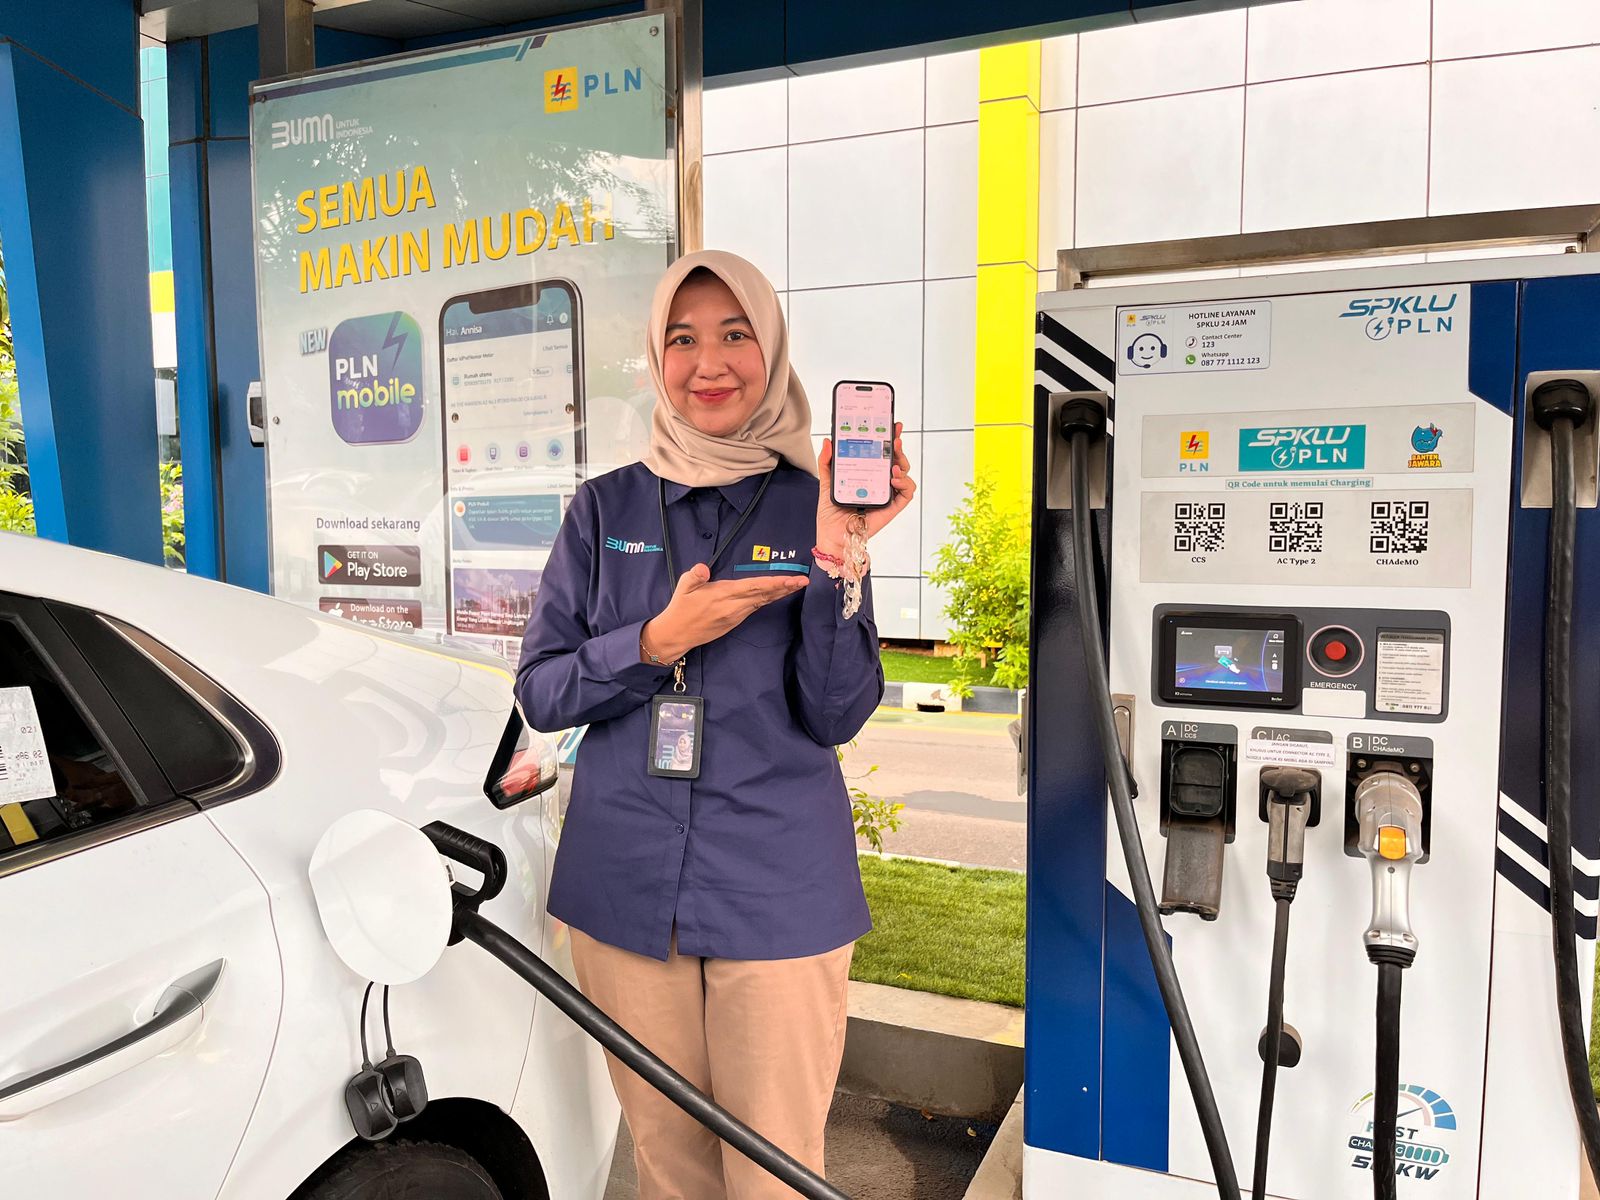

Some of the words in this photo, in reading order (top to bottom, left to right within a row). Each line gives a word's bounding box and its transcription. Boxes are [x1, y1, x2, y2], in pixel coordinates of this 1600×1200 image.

[584, 67, 641, 98] PLN
[336, 118, 360, 129] UNTUK
[336, 126, 374, 139] INDONESIA
[295, 165, 437, 234] SEMUA
[299, 227, 431, 294] MAKIN
[443, 192, 615, 269] MUDAH
[1338, 293, 1457, 318] SPKLU
[1188, 311, 1220, 320] HOTLINE
[1221, 309, 1256, 318] LAYANAN
[460, 325, 483, 336] Annisa
[1397, 316, 1453, 335] PLN
[300, 328, 328, 355] NEW
[335, 354, 378, 381] PLN
[336, 377, 416, 410] mobile
[1248, 427, 1351, 447] SPKLU
[1298, 448, 1347, 464] PLN
[1179, 462, 1209, 472] PLN
[1407, 460, 1442, 468] JAWARA
[1263, 480, 1288, 488] untuk
[1290, 479, 1328, 487] memulai
[1330, 478, 1371, 488] Charging
[316, 517, 369, 530] Download
[371, 517, 421, 532] sekarang
[347, 551, 361, 559] GET
[361, 551, 367, 559] IT
[368, 551, 379, 559] ON
[771, 550, 796, 560] PLN
[1289, 558, 1309, 566] Type
[1376, 558, 1419, 566] CHAdeMO
[347, 562, 370, 581] Play
[373, 563, 408, 578] Store
[350, 604, 385, 614] Download
[386, 606, 395, 614] on
[397, 605, 409, 614] the
[1310, 682, 1357, 690] EMERGENCY
[1166, 725, 1177, 736] A
[1184, 724, 1199, 732] DC
[1257, 731, 1267, 740] C
[1372, 736, 1388, 745] DC
[1353, 737, 1363, 749] B
[1365, 1121, 1418, 1140] FST
